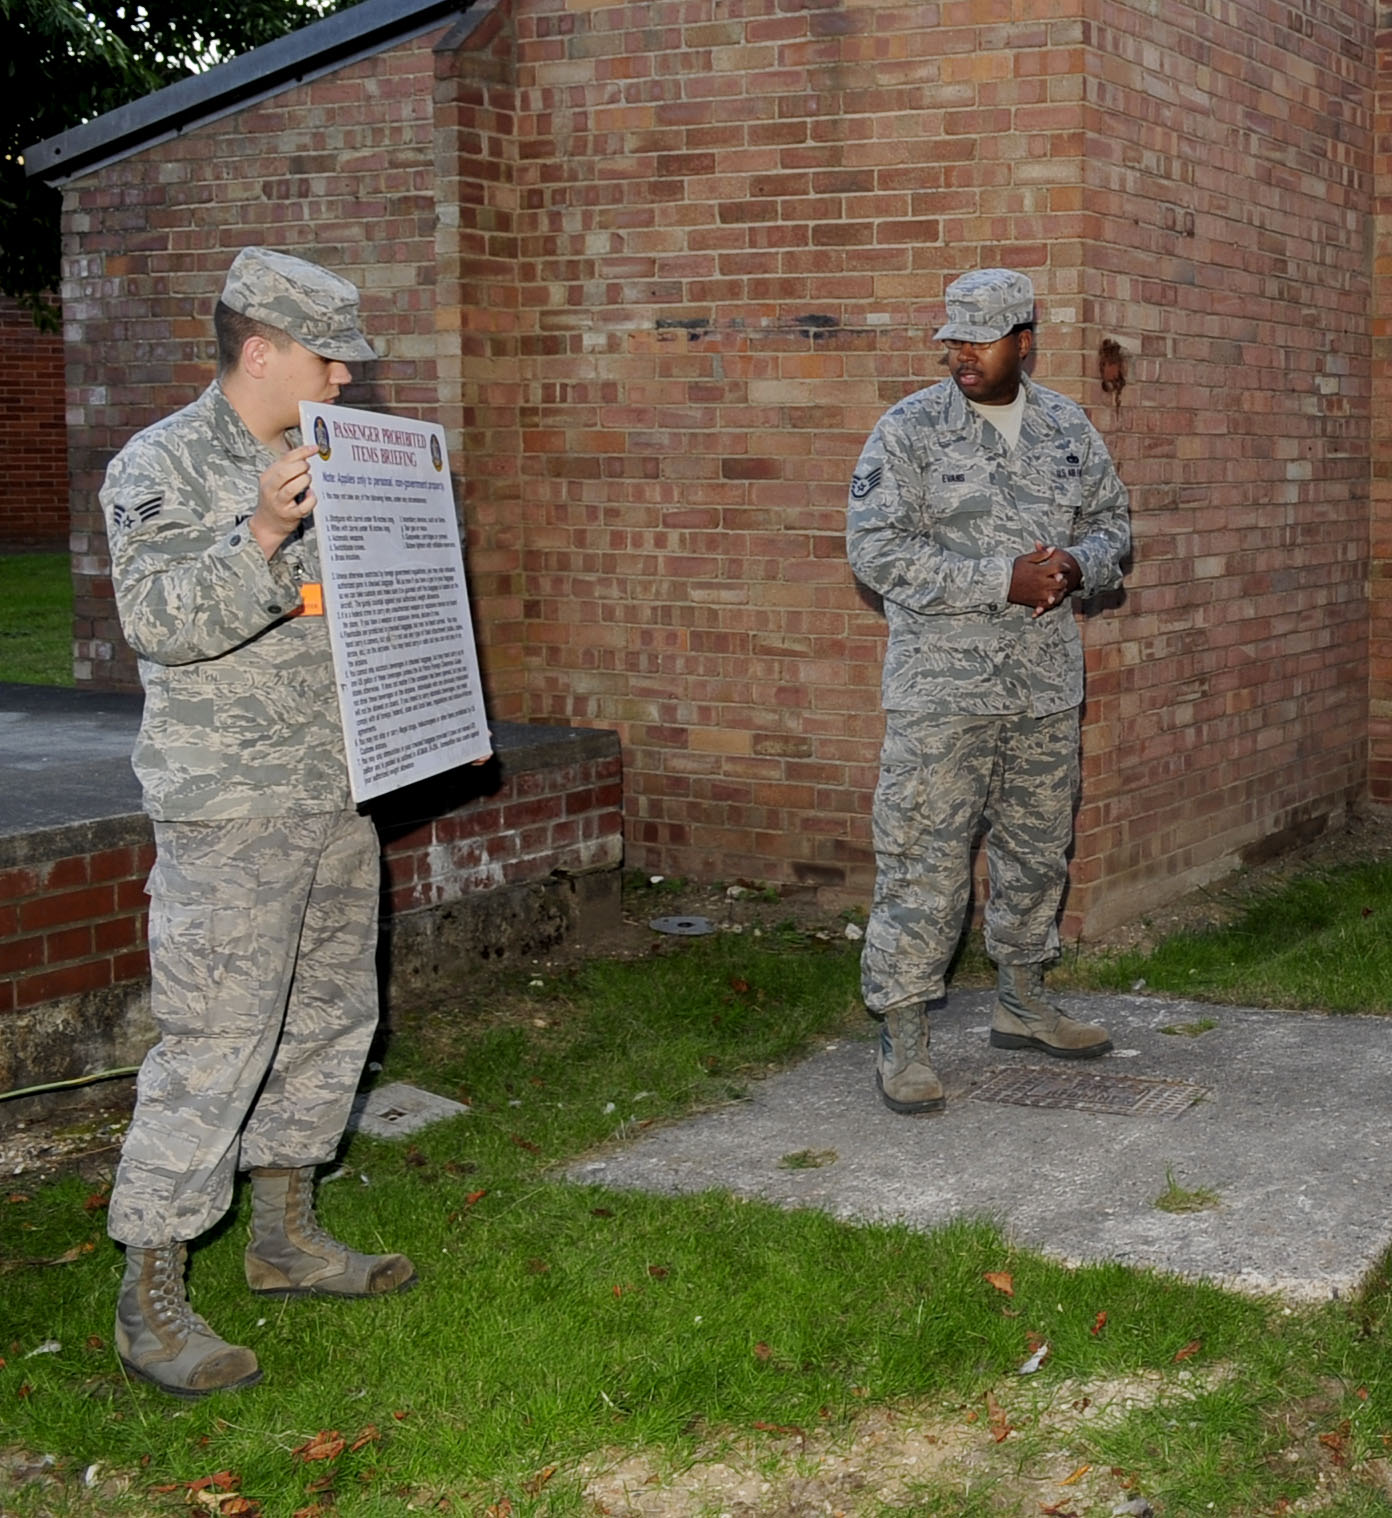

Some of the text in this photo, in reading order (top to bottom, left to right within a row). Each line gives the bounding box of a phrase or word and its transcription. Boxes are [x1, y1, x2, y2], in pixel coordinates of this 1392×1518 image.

[333, 421, 427, 448] PASSENGER PROHIBITED
[351, 444, 417, 467] ITEMS BRIEFING
[942, 473, 965, 483] EVANS
